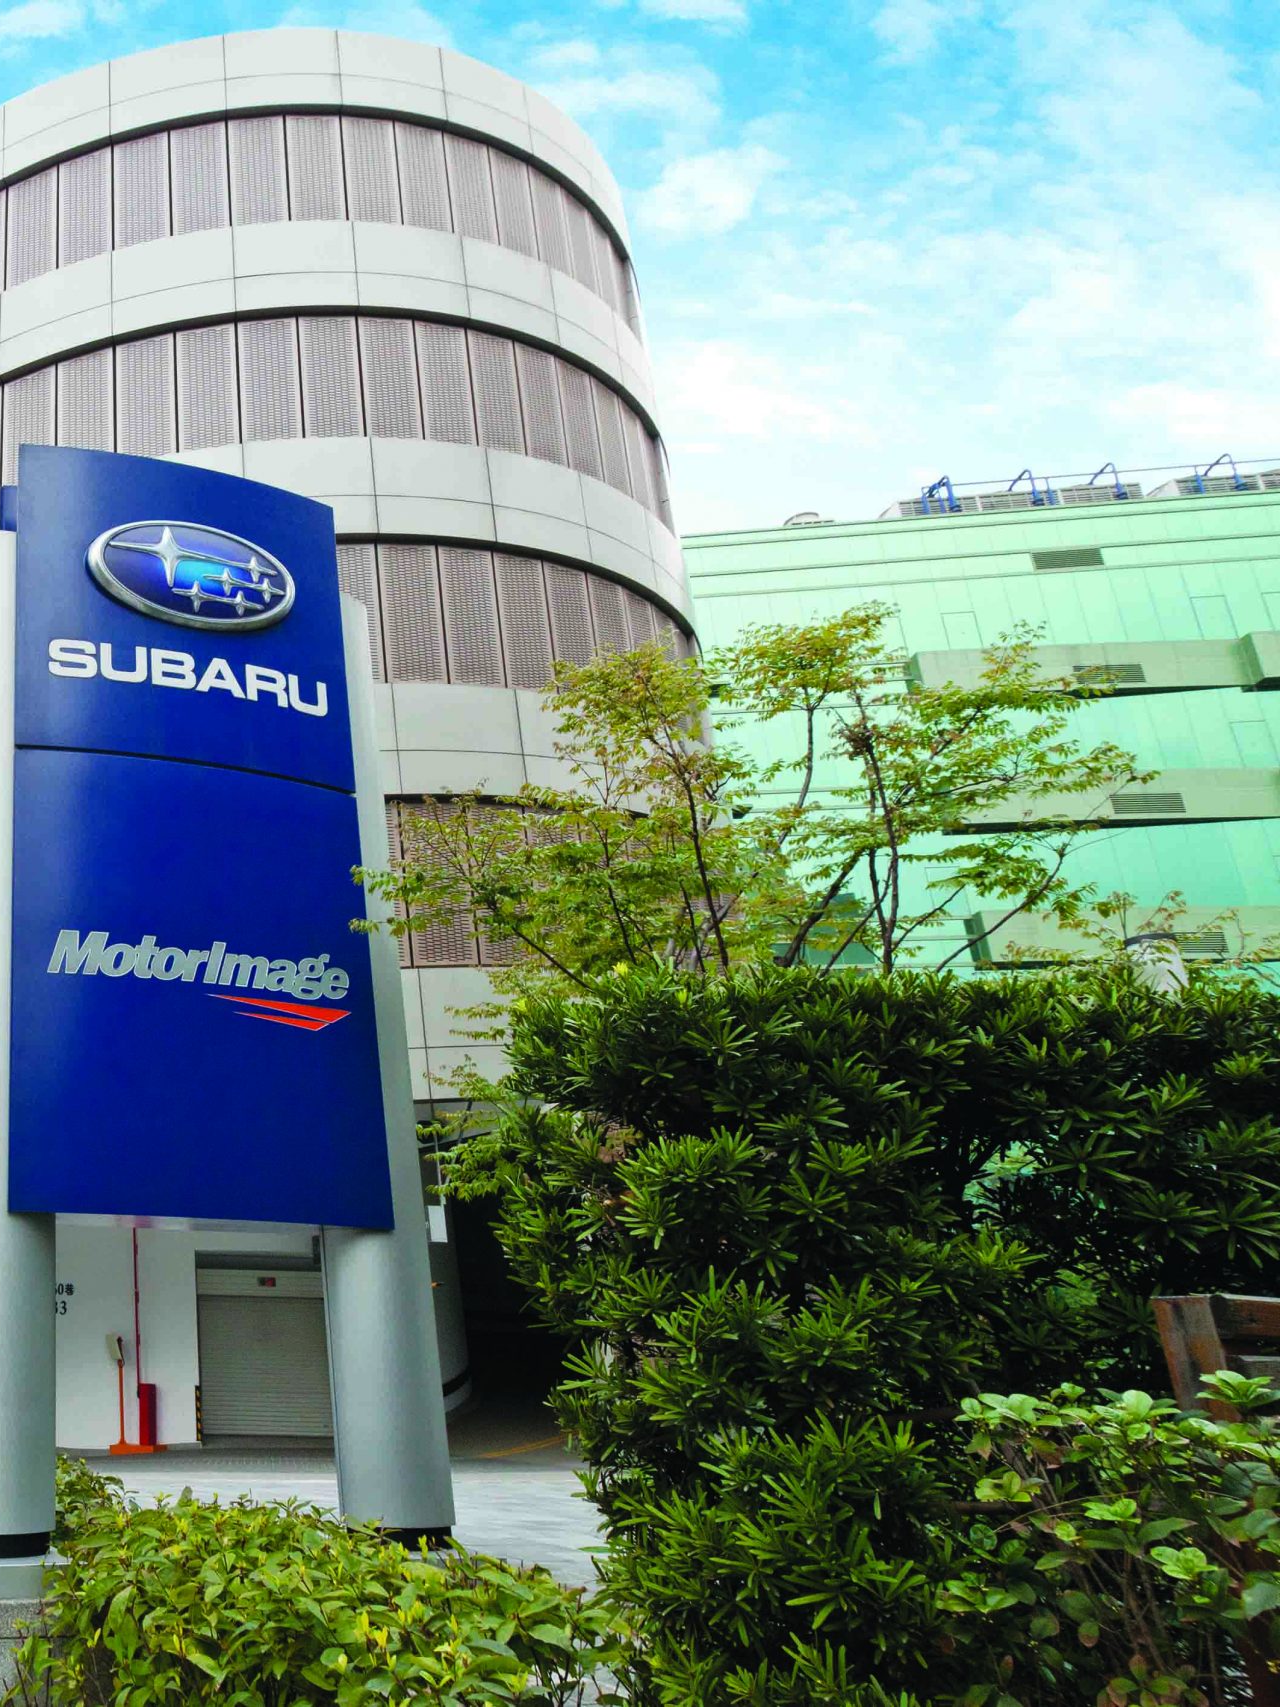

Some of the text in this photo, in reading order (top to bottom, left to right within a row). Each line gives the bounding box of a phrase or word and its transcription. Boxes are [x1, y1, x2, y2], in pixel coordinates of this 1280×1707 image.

[48, 638, 328, 717] SUBARU
[47, 929, 350, 1000] MotorImage
[55, 1282, 75, 1296] 0巷
